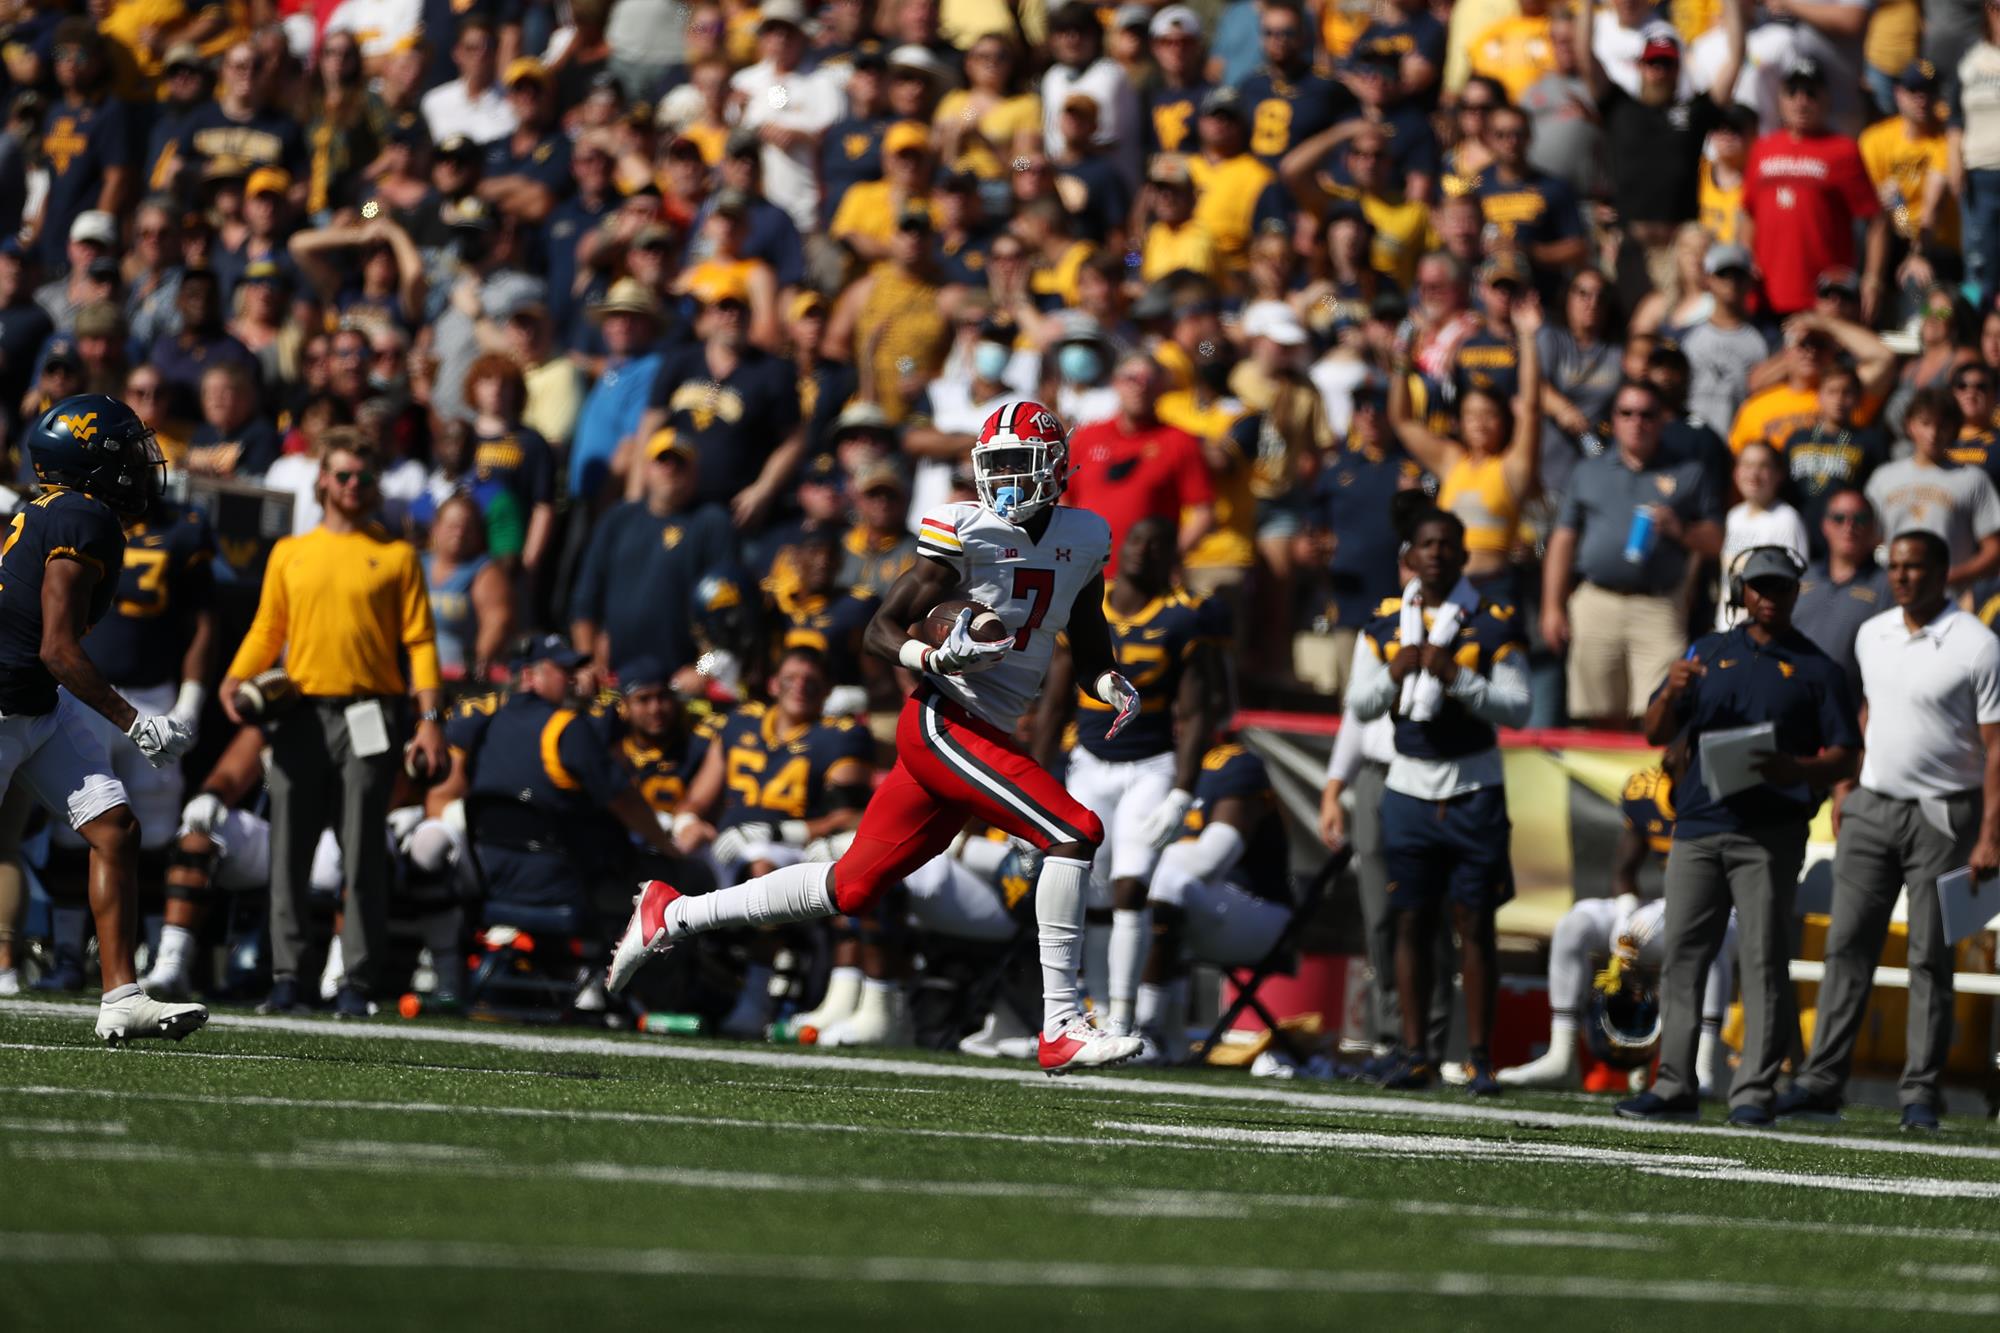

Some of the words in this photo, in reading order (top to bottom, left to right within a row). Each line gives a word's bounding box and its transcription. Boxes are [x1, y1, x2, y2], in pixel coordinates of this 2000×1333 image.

[119, 546, 169, 617] 3
[1012, 567, 1055, 652] 7
[726, 746, 809, 817] 54
